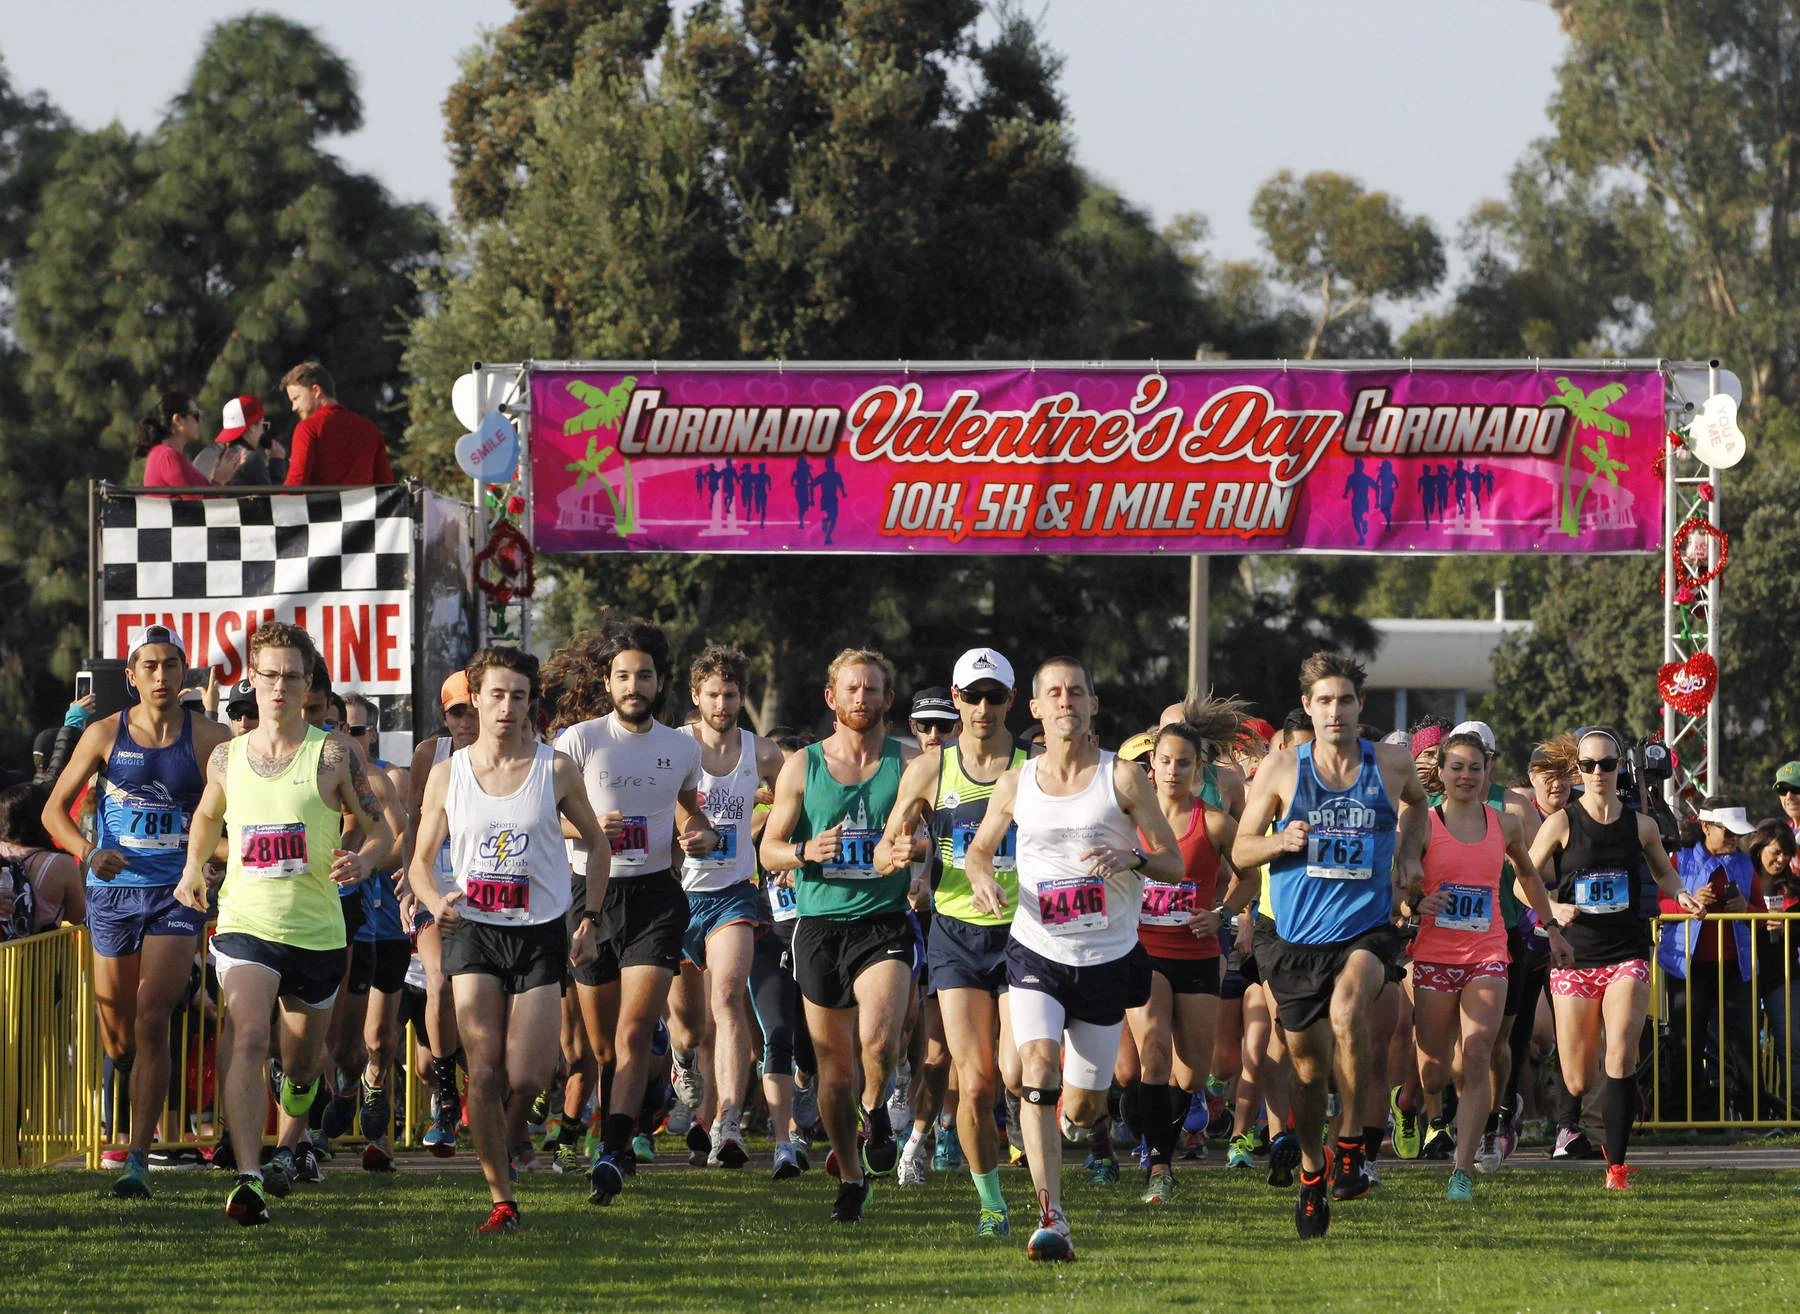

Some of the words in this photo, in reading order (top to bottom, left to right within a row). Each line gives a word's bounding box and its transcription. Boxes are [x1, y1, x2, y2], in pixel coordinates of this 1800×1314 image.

[618, 389, 842, 453] CORONADO
[849, 375, 1183, 463] Valentine's
[1181, 386, 1343, 486] Day
[1344, 388, 1566, 454] CORONADO
[1716, 404, 1732, 438] YOU
[470, 428, 507, 465] SMILE
[1708, 422, 1722, 449] ME
[885, 482, 963, 534] 10K,
[973, 482, 1035, 531] 5K
[1034, 482, 1074, 531] &
[1081, 482, 1104, 531] 1
[1103, 482, 1207, 531] MILE
[1205, 482, 1294, 531] RUN
[708, 795, 745, 804] DIEGO
[710, 788, 730, 797] SAN
[707, 803, 744, 812] TRACK
[712, 811, 743, 820] CLUB
[1308, 807, 1376, 829] PRADO
[130, 810, 173, 835] 789
[489, 820, 518, 829] Storm
[242, 834, 304, 863] 2800
[1316, 838, 1364, 865] 762
[504, 858, 528, 867] Club
[467, 881, 526, 909] 2041
[1039, 887, 1103, 920] 2446
[1141, 888, 1194, 913] 2785
[1590, 880, 1615, 902] 95
